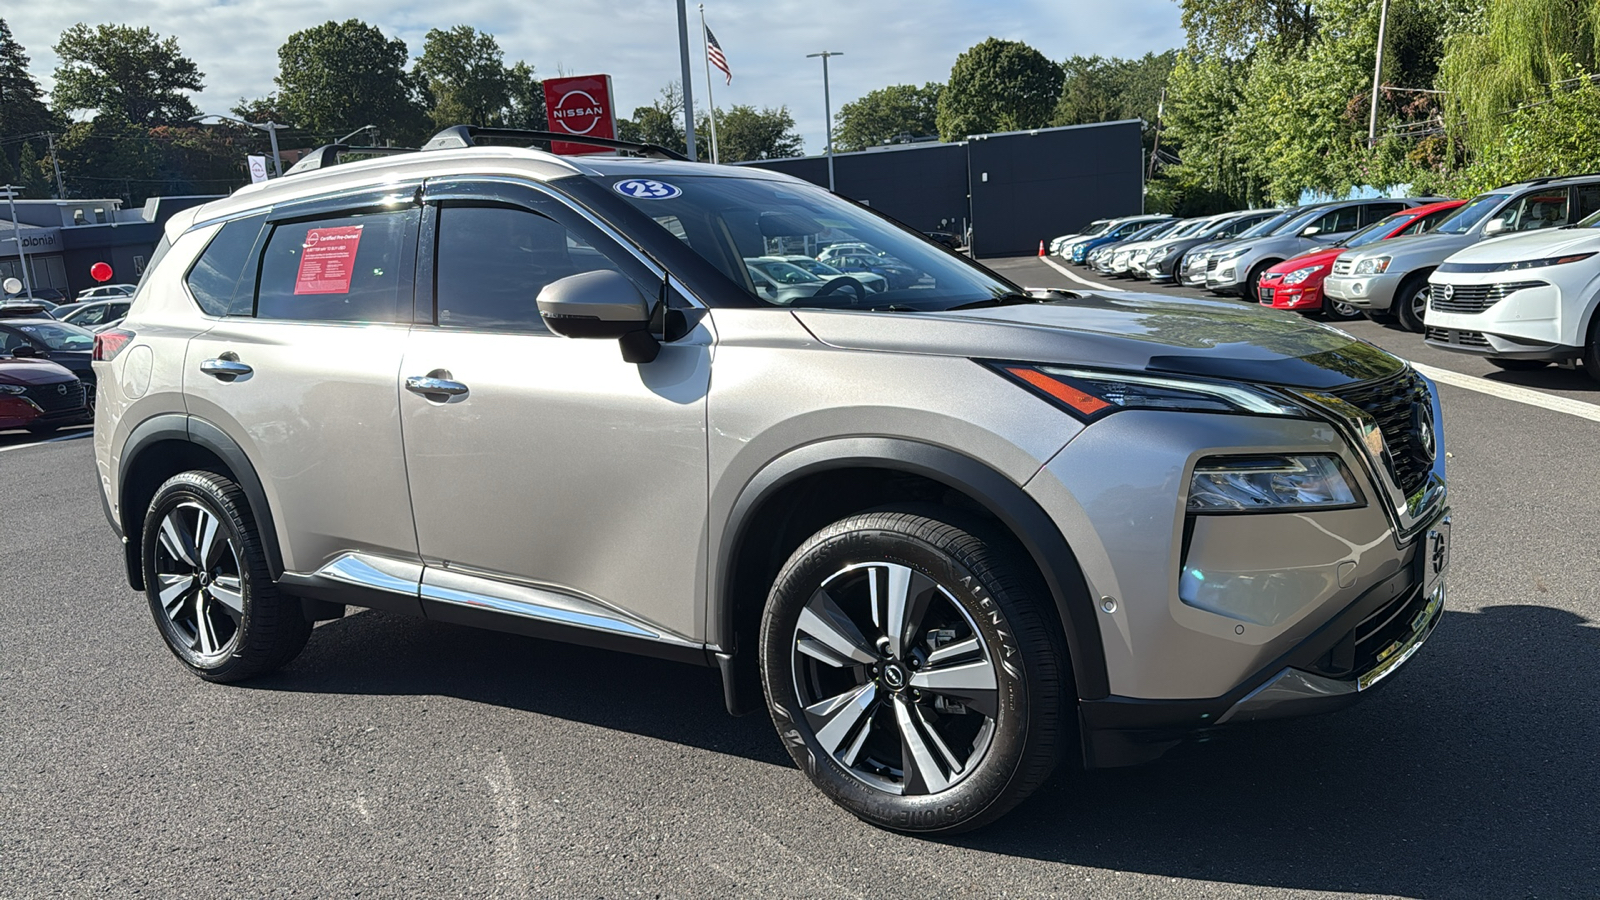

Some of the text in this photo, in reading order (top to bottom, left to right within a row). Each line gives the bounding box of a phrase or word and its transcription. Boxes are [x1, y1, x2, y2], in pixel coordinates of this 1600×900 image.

[553, 106, 603, 118] NISSAN
[626, 181, 669, 197] 23
[960, 575, 1017, 658] ALENZA
